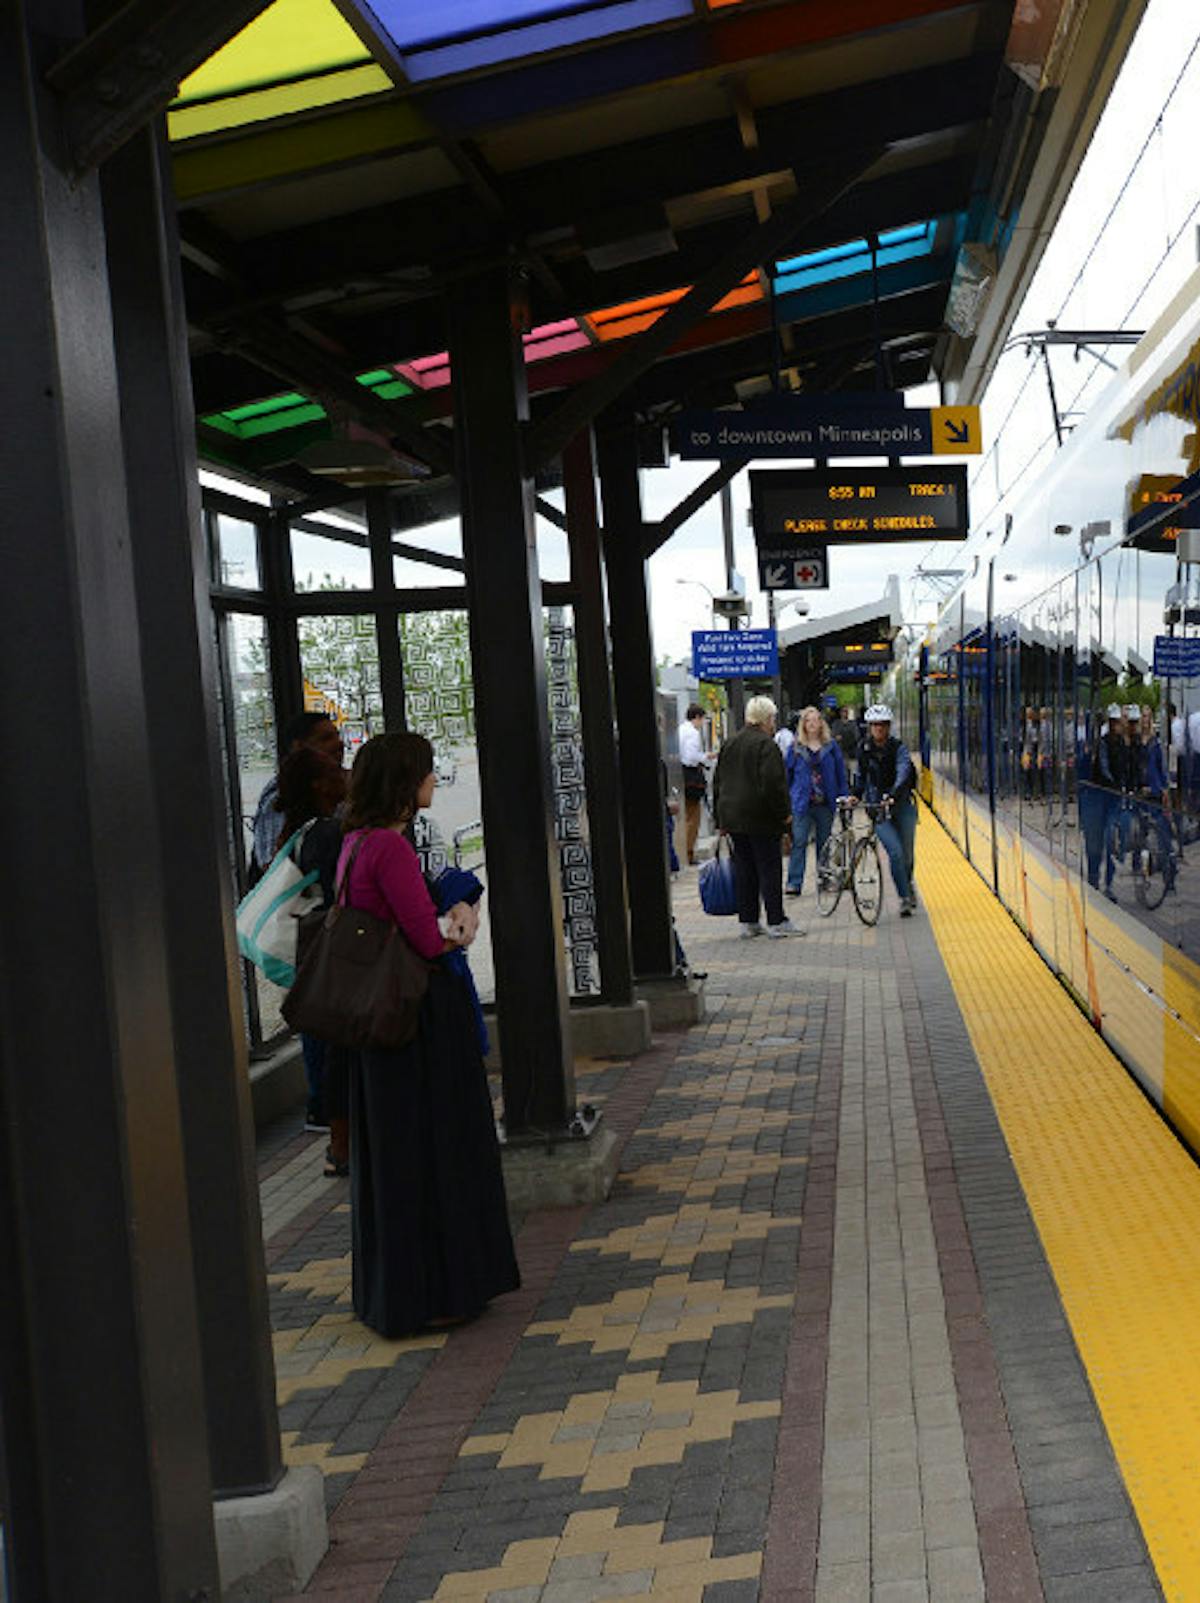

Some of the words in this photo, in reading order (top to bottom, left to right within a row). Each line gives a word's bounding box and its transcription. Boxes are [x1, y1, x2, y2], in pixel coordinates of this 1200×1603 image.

[690, 430, 711, 446] to
[717, 426, 813, 445] downtown
[818, 424, 923, 446] Minneapolis
[908, 483, 945, 497] TRACK
[784, 519, 828, 533] PLEASE
[832, 517, 869, 532] CHECK
